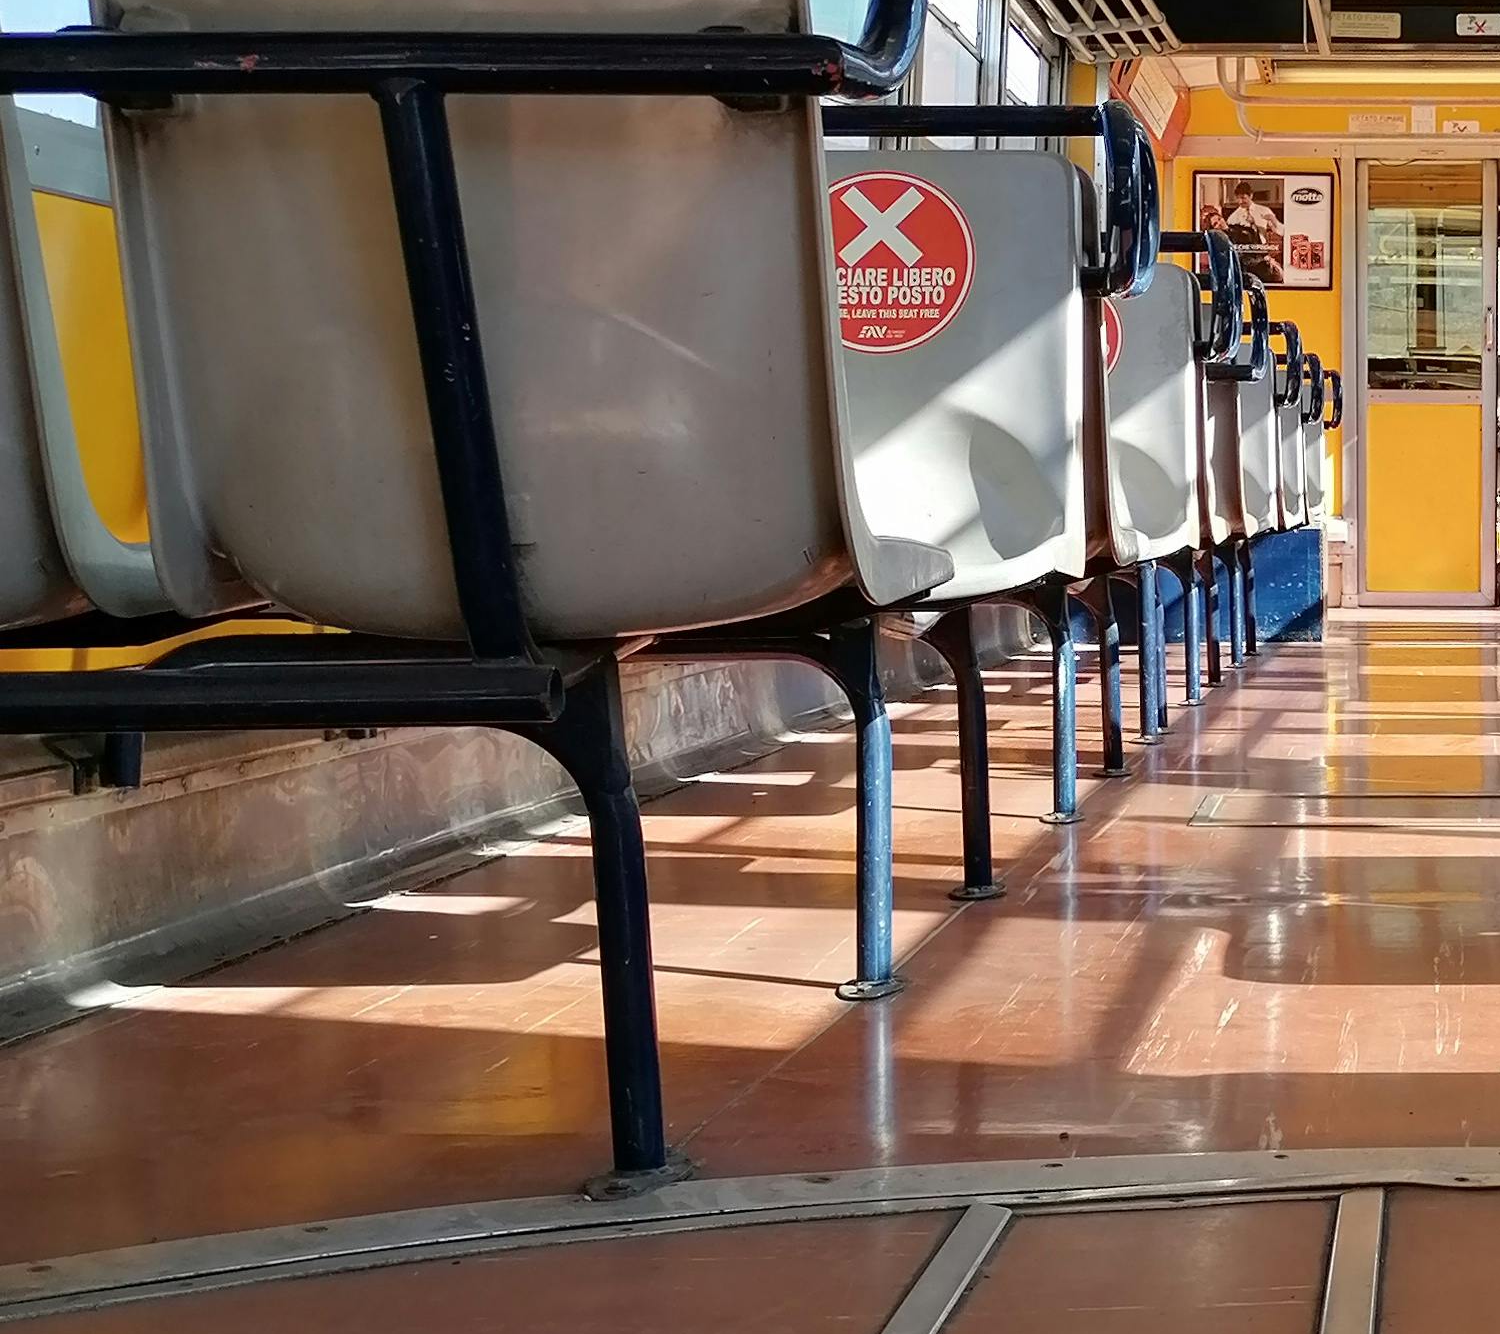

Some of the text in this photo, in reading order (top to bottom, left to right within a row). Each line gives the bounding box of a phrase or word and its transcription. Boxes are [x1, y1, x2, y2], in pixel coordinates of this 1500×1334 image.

[836, 267, 956, 286] CIARE LIBERO
[838, 286, 945, 305] ESTO POSTO
[852, 308, 877, 319] LEAVE
[878, 308, 897, 319] THIS
[899, 308, 919, 319] SEAT
[920, 308, 940, 319] FREE
